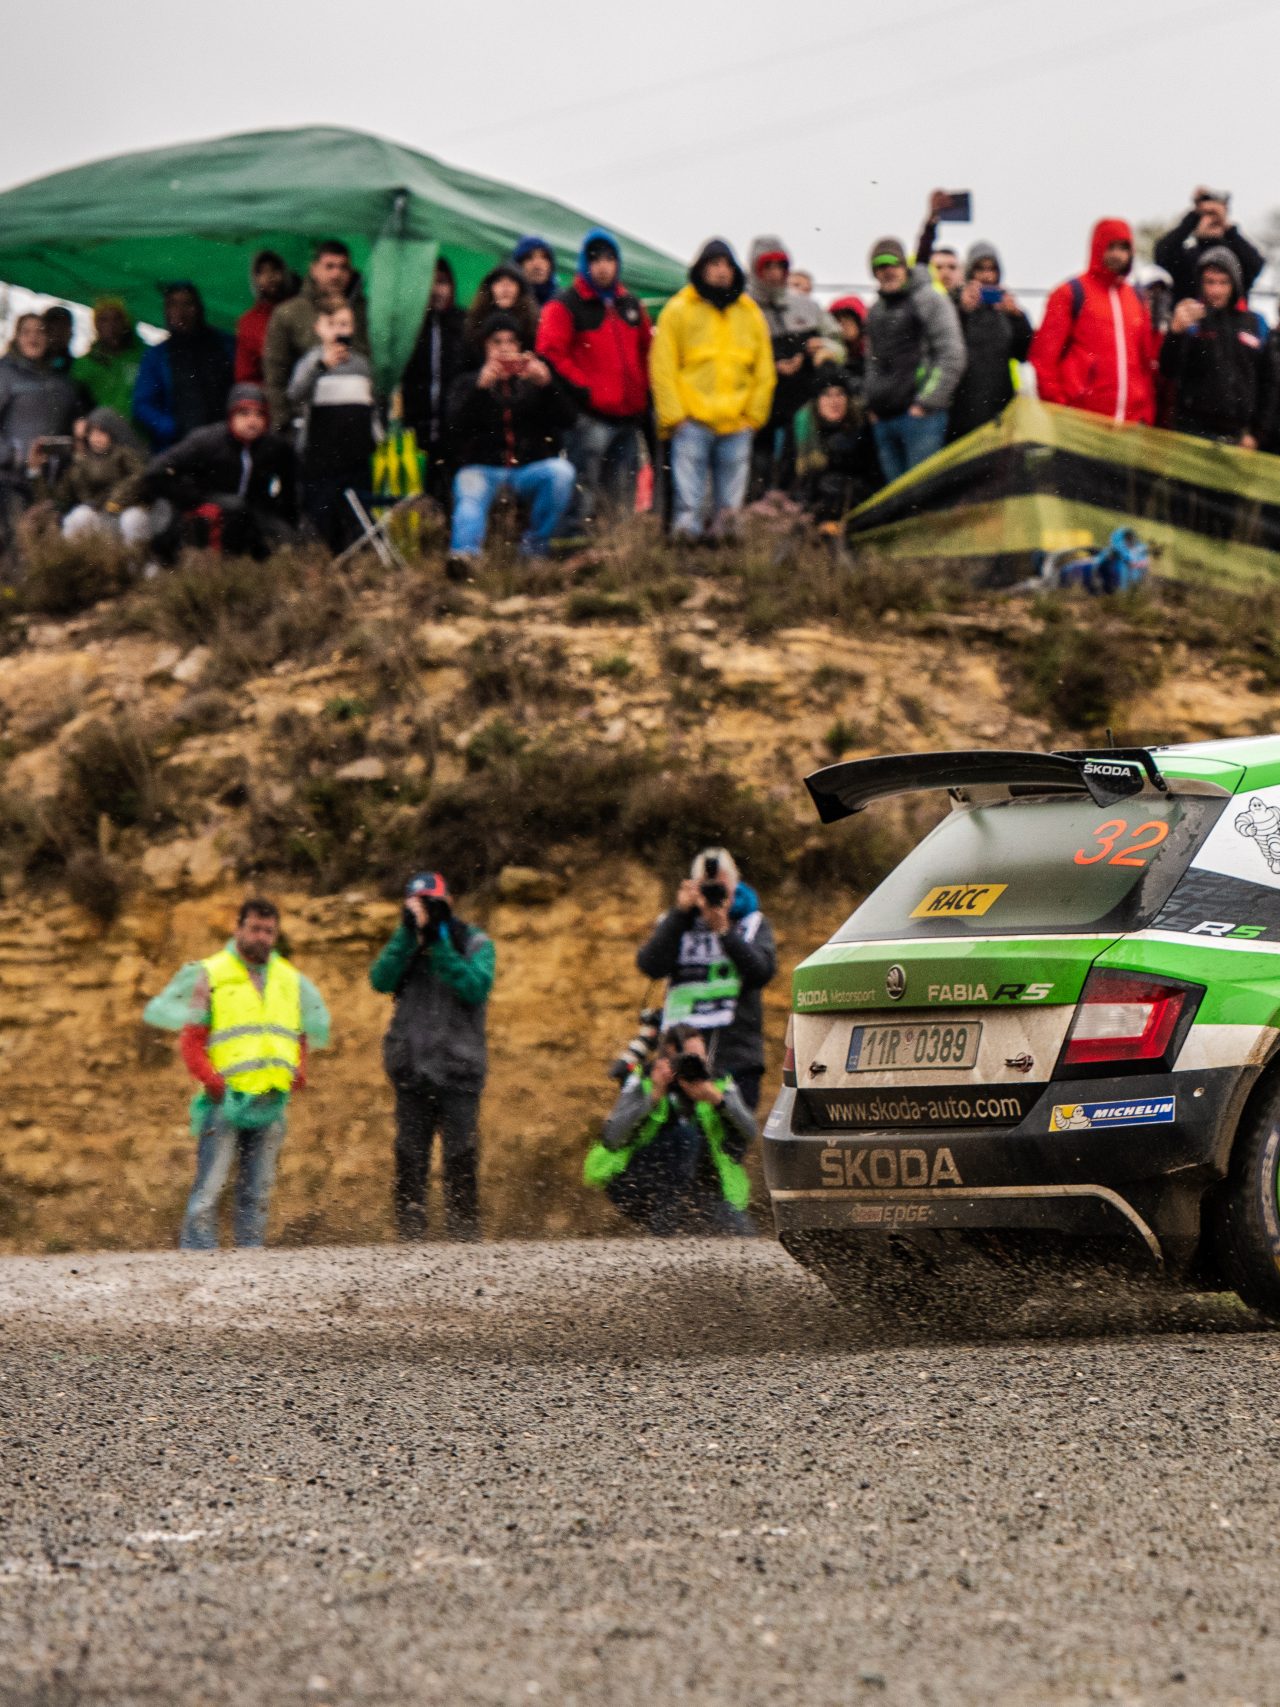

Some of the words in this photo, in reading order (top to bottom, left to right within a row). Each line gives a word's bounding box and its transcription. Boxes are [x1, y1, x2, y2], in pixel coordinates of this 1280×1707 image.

[1083, 762, 1131, 777] ŠKODA
[1074, 820, 1169, 867] 32
[925, 888, 989, 912] RACC
[1188, 920, 1268, 939] R5
[928, 983, 989, 1001] FABIA
[993, 983, 1054, 1000] R5
[867, 1029, 901, 1066] 11R
[914, 1027, 968, 1063] 0389
[825, 1096, 1022, 1122] www.skoda-auto.com
[1092, 1103, 1173, 1119] MICHELIN
[819, 1141, 963, 1188] ŠKODA
[884, 1205, 931, 1222] EDGE
